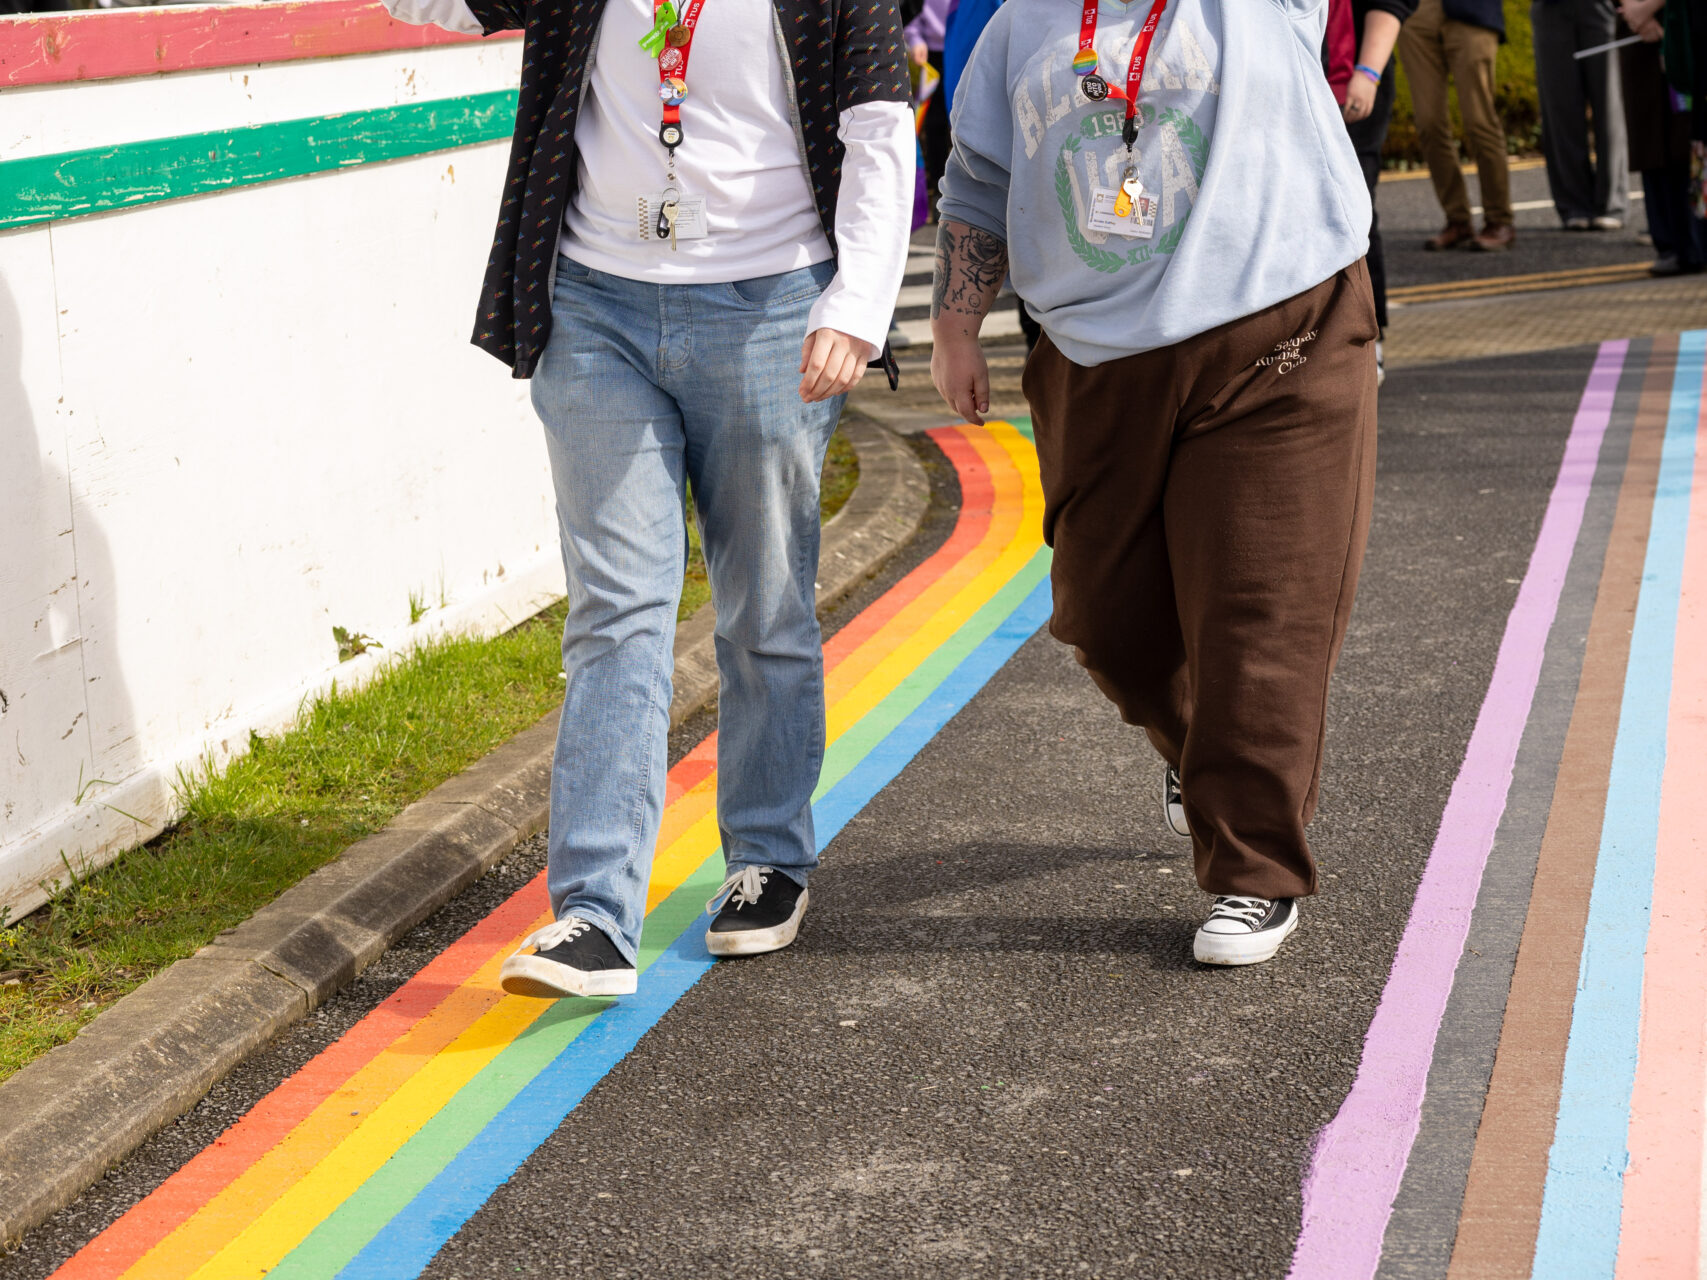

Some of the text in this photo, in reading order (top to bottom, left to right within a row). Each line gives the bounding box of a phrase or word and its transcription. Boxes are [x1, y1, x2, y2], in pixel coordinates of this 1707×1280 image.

[689, 2, 700, 18] TUS
[1085, 14, 1093, 25] TUS
[1148, 13, 1158, 25] TUS
[1132, 56, 1142, 72] TUS
